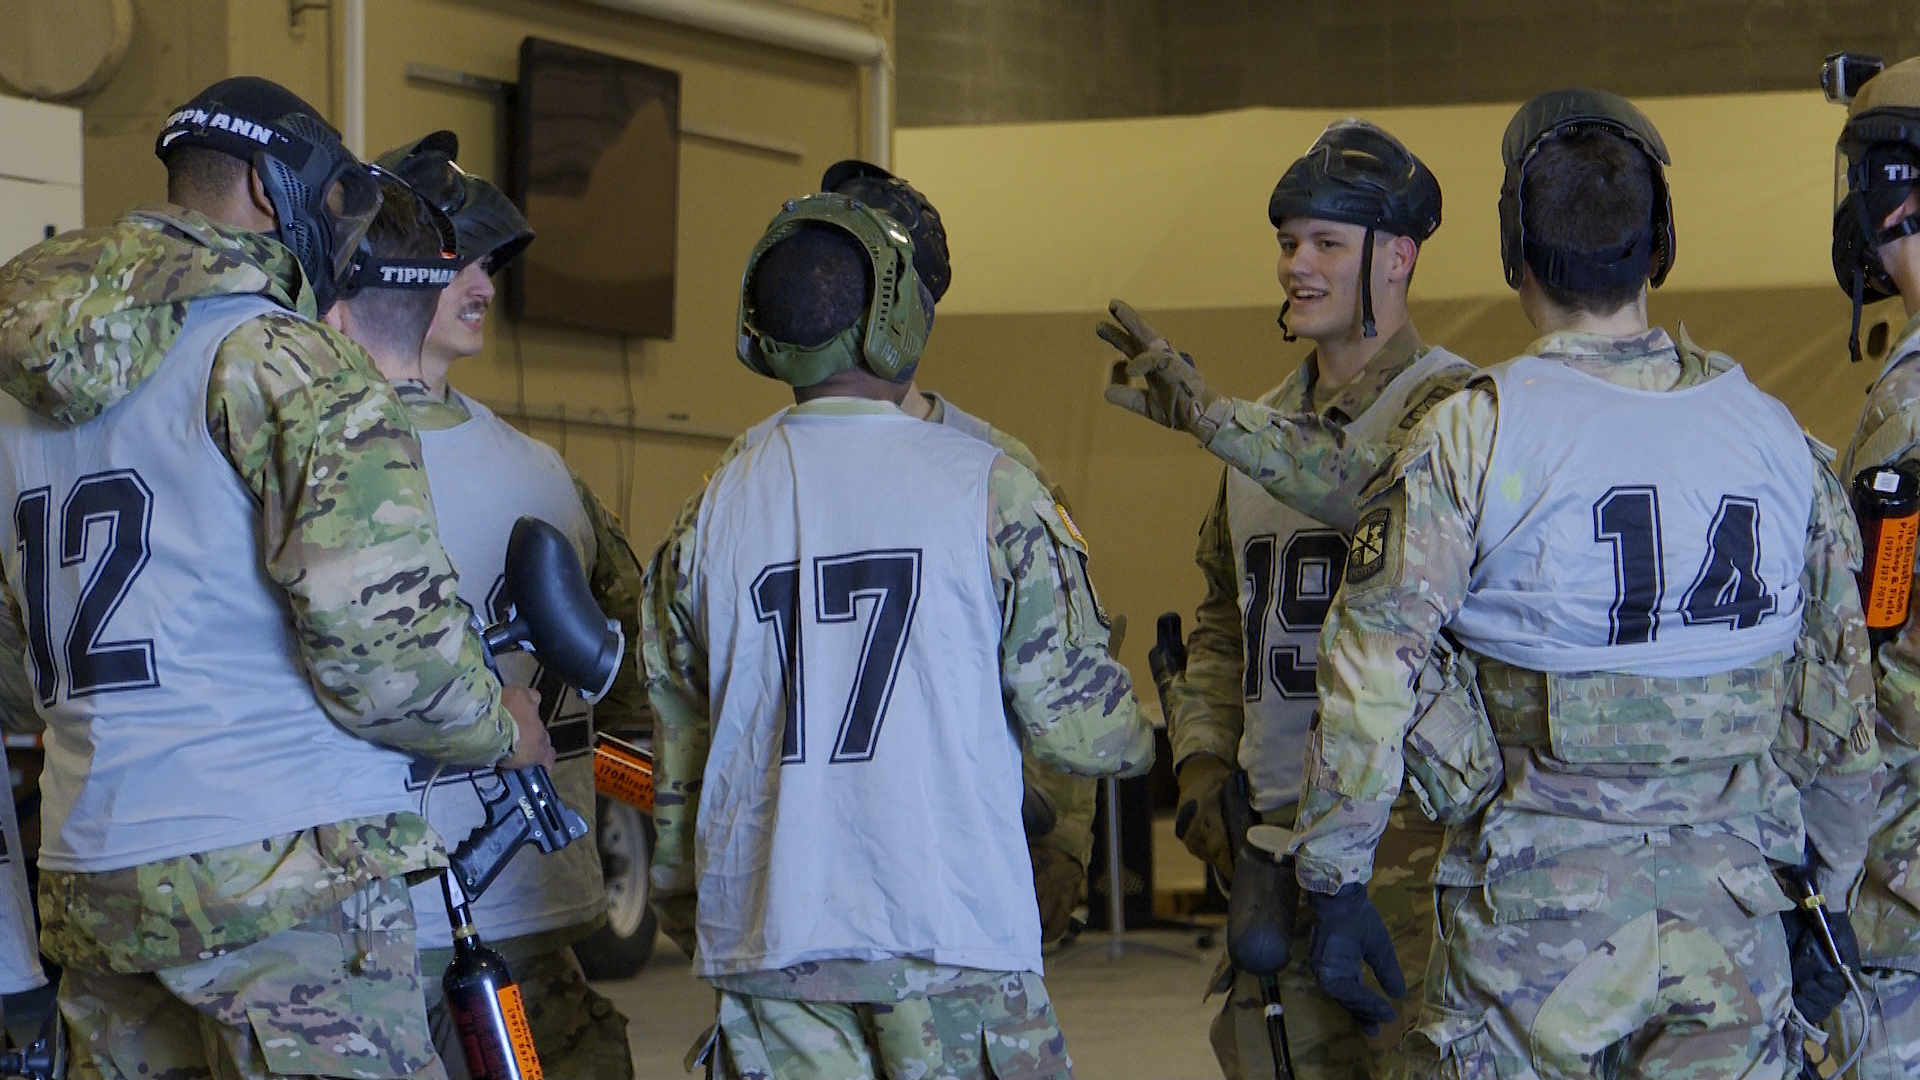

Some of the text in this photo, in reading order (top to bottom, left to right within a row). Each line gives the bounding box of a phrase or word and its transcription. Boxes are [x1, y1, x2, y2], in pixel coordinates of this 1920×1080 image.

[14, 469, 160, 708] 12
[750, 548, 922, 767] 17
[1244, 529, 1352, 702] 19
[1593, 485, 1778, 646] 14
